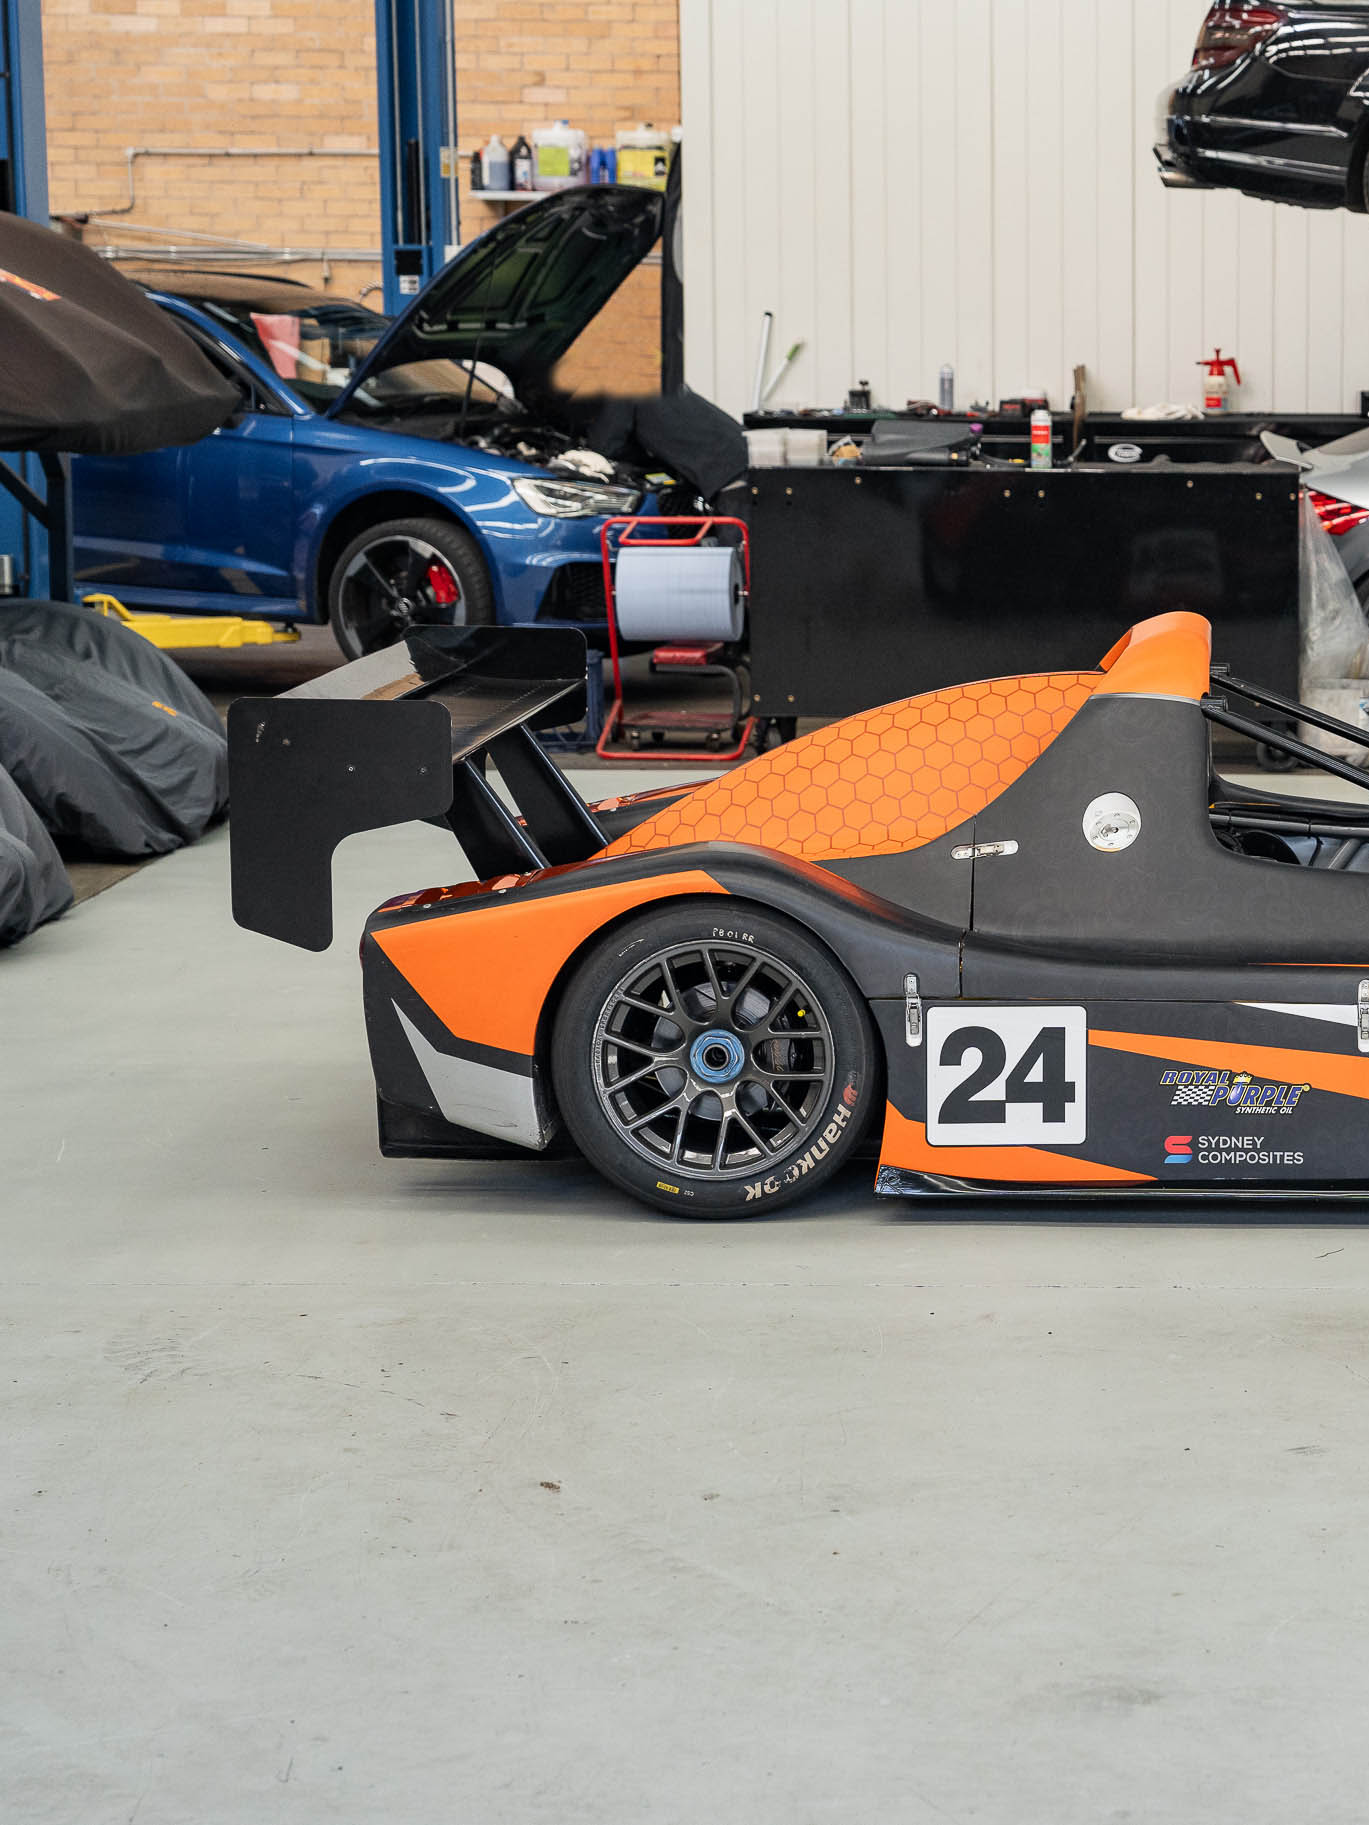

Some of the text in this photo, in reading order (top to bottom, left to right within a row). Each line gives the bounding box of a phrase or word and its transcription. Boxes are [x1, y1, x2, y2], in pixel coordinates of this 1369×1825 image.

[938, 1025, 1075, 1124] 24
[1160, 1070, 1231, 1086] ROYAL
[1209, 1085, 1304, 1107] PURPLE
[1235, 1106, 1293, 1115] SYNTHETIC OIL
[1198, 1136, 1265, 1149] SYDNEY
[1198, 1151, 1304, 1165] COMPOSITES
